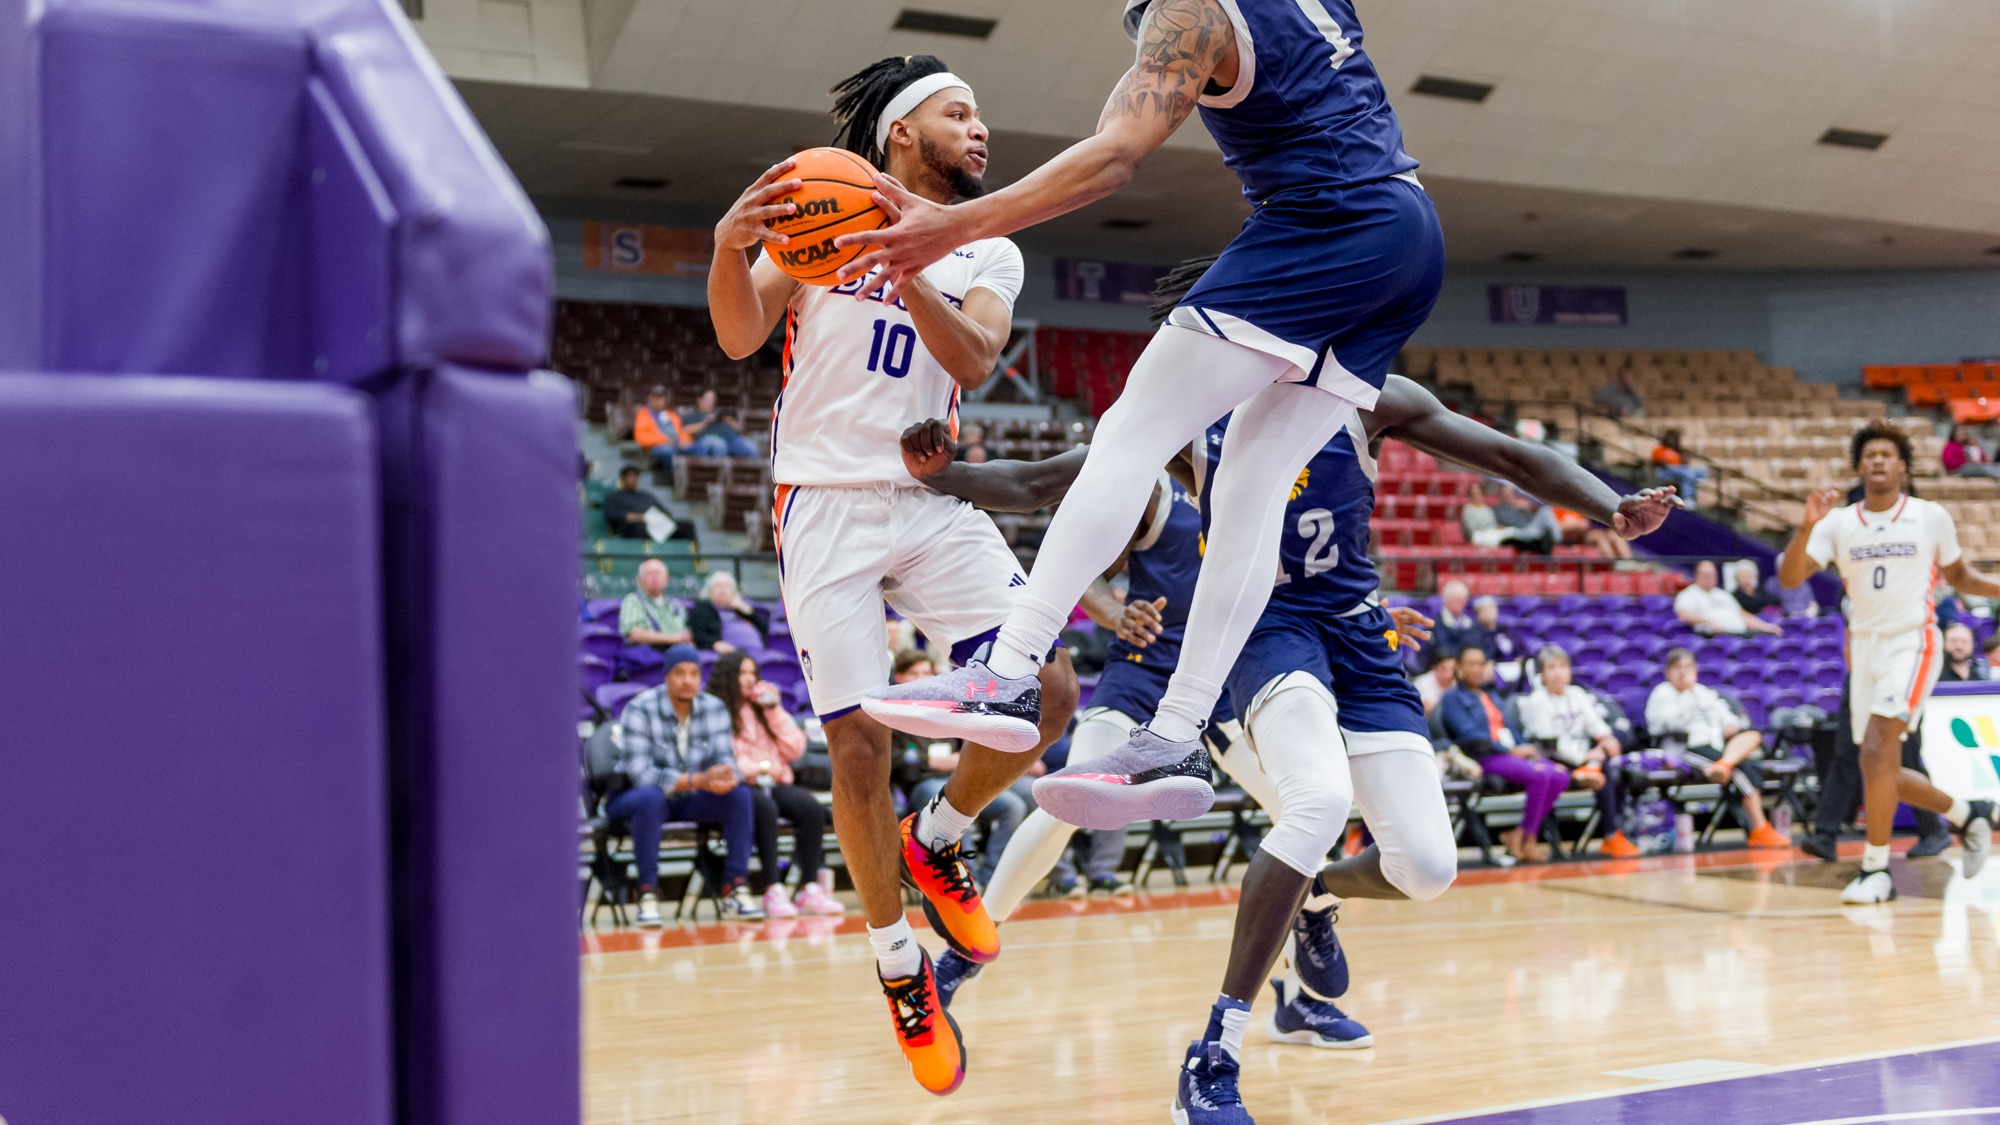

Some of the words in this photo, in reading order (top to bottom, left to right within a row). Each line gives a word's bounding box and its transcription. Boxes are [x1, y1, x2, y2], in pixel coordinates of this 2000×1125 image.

[778, 237, 841, 267] NCAA
[867, 319, 916, 378] 10
[1275, 507, 1339, 586] 2
[1873, 566, 1886, 589] 0
